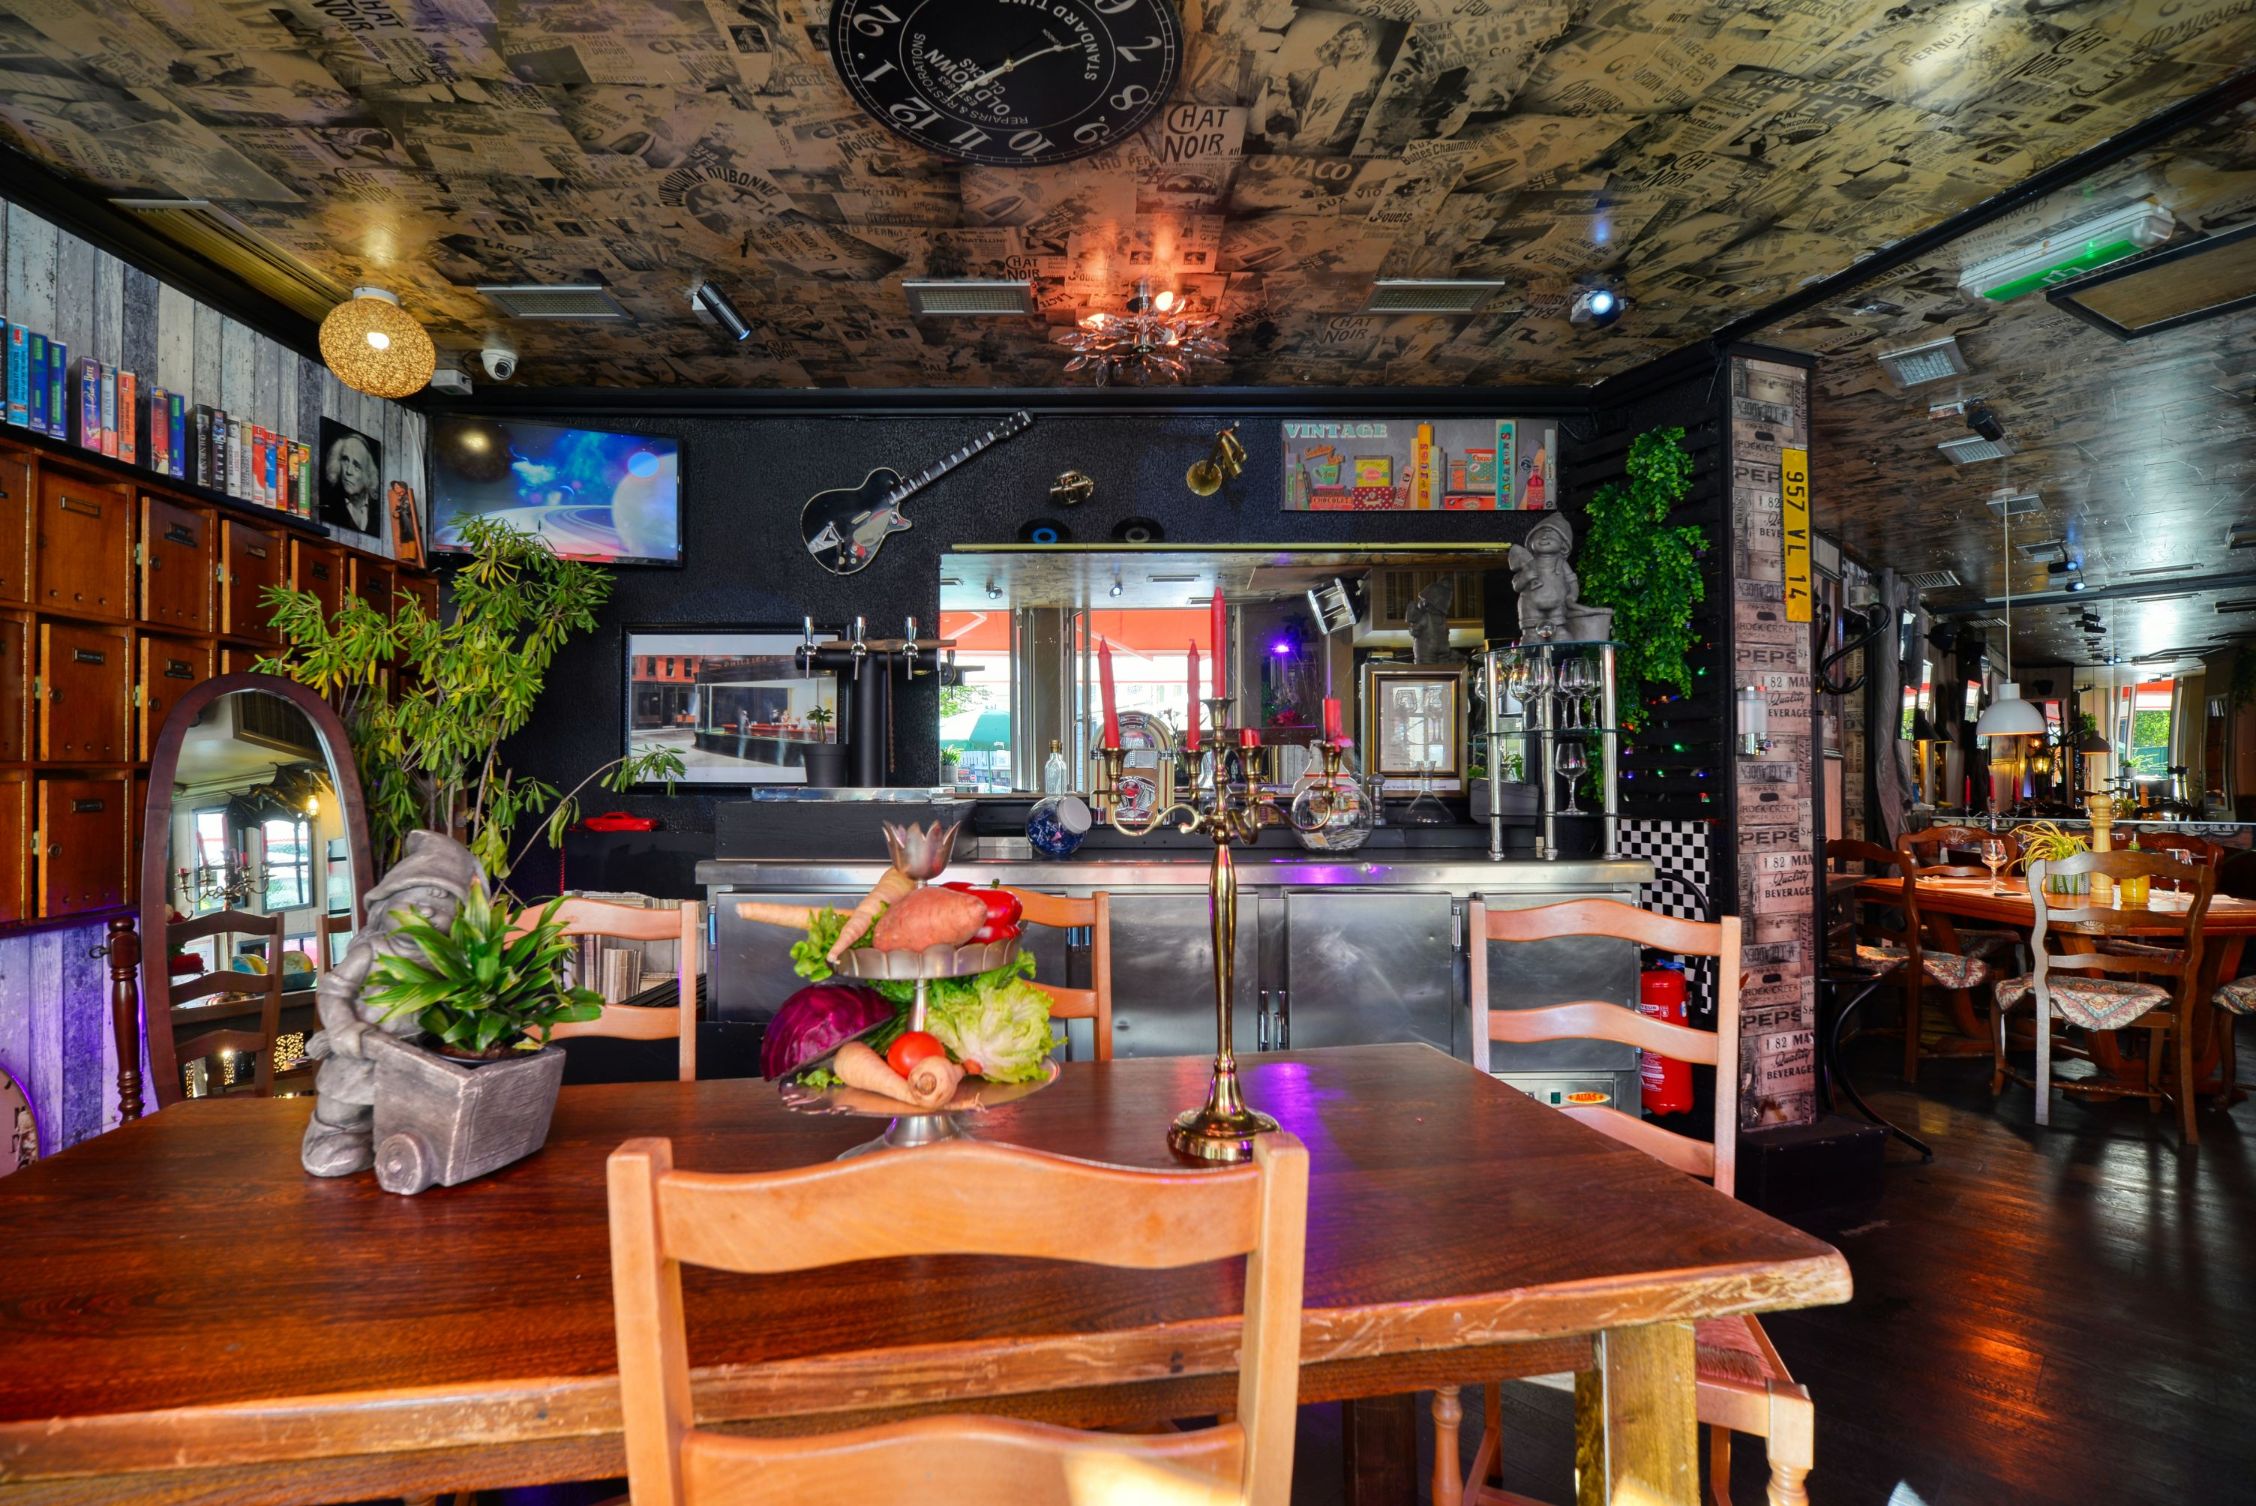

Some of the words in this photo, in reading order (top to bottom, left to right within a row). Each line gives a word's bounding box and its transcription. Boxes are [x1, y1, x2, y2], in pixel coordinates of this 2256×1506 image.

[1053, 5, 1100, 81] STANDARD
[924, 48, 970, 87] OWN
[959, 58, 1006, 95] CLCKS
[974, 88, 1011, 116] OLD
[1110, 85, 1149, 110] 8
[889, 97, 945, 132] 12
[969, 110, 1029, 125] REPAIRS
[1167, 102, 1230, 134] CHAT
[950, 124, 992, 152] 11
[1009, 130, 1057, 156] 10
[1160, 134, 1225, 163] NOIR
[1671, 150, 1716, 171] CHAT
[706, 167, 781, 198] DUBONNET
[1641, 169, 1695, 188] NOIR
[1005, 255, 1041, 270] CHAT
[1006, 268, 1041, 282] NOIR
[1329, 316, 1377, 330] CHAT
[1321, 329, 1371, 345] NOIR
[1284, 423, 1388, 439] VINTAGE
[1501, 432, 1511, 505] MACARONS
[1786, 471, 1805, 512] 957
[1787, 528, 1806, 557] VL
[1788, 575, 1808, 599] 14
[1773, 856, 1786, 868] 82
[1775, 1036, 1788, 1049] 82
